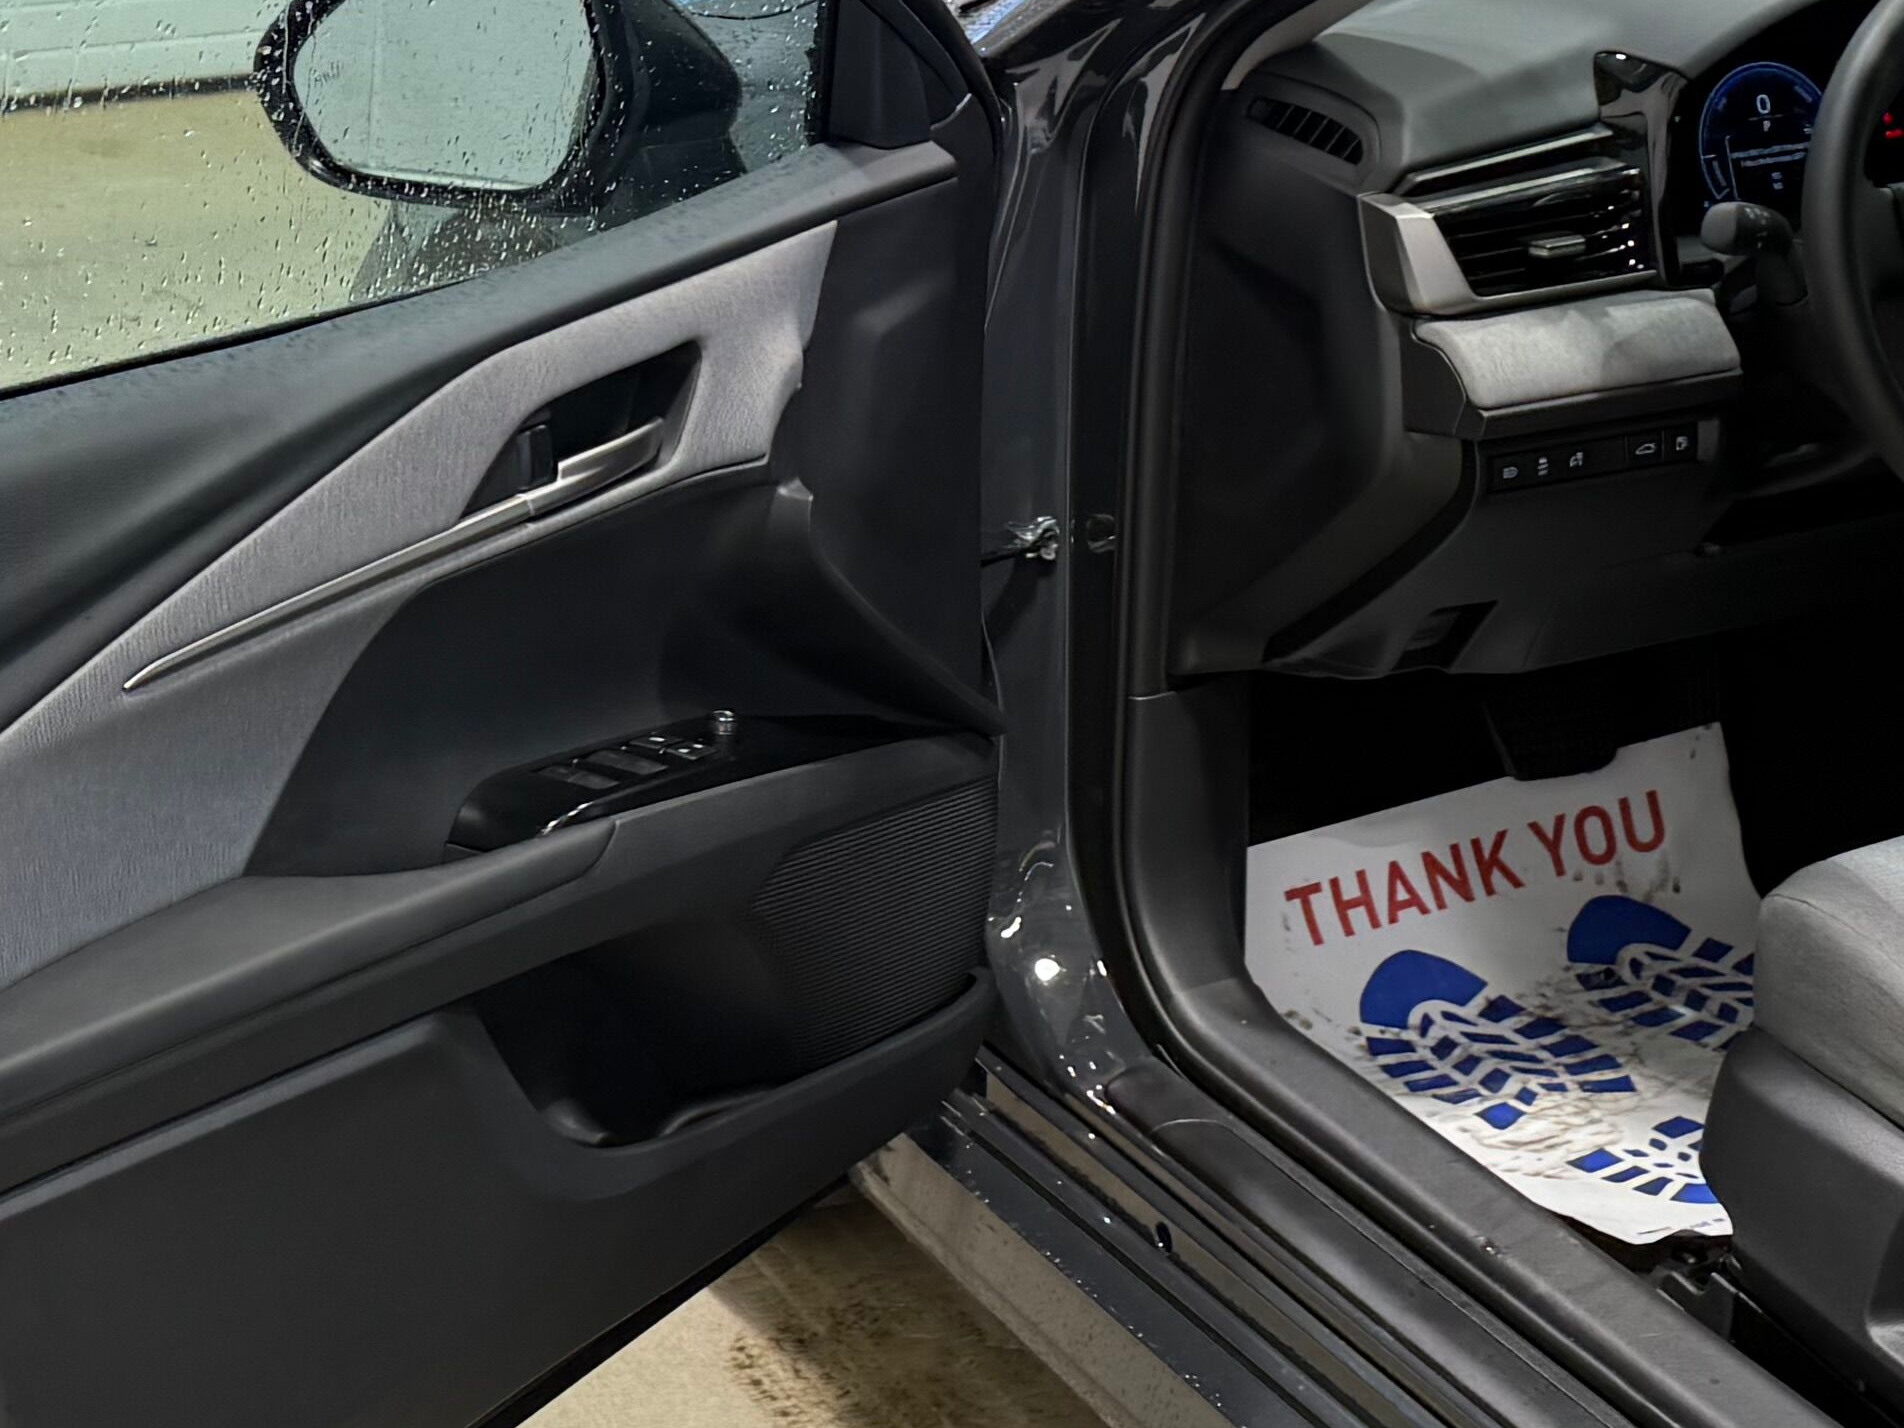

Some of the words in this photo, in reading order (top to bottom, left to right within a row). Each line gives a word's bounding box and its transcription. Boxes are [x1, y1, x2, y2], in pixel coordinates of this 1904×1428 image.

[1756, 93, 1771, 115] 0
[1283, 828, 1526, 947] THANK
[1527, 789, 1666, 878] YOU
